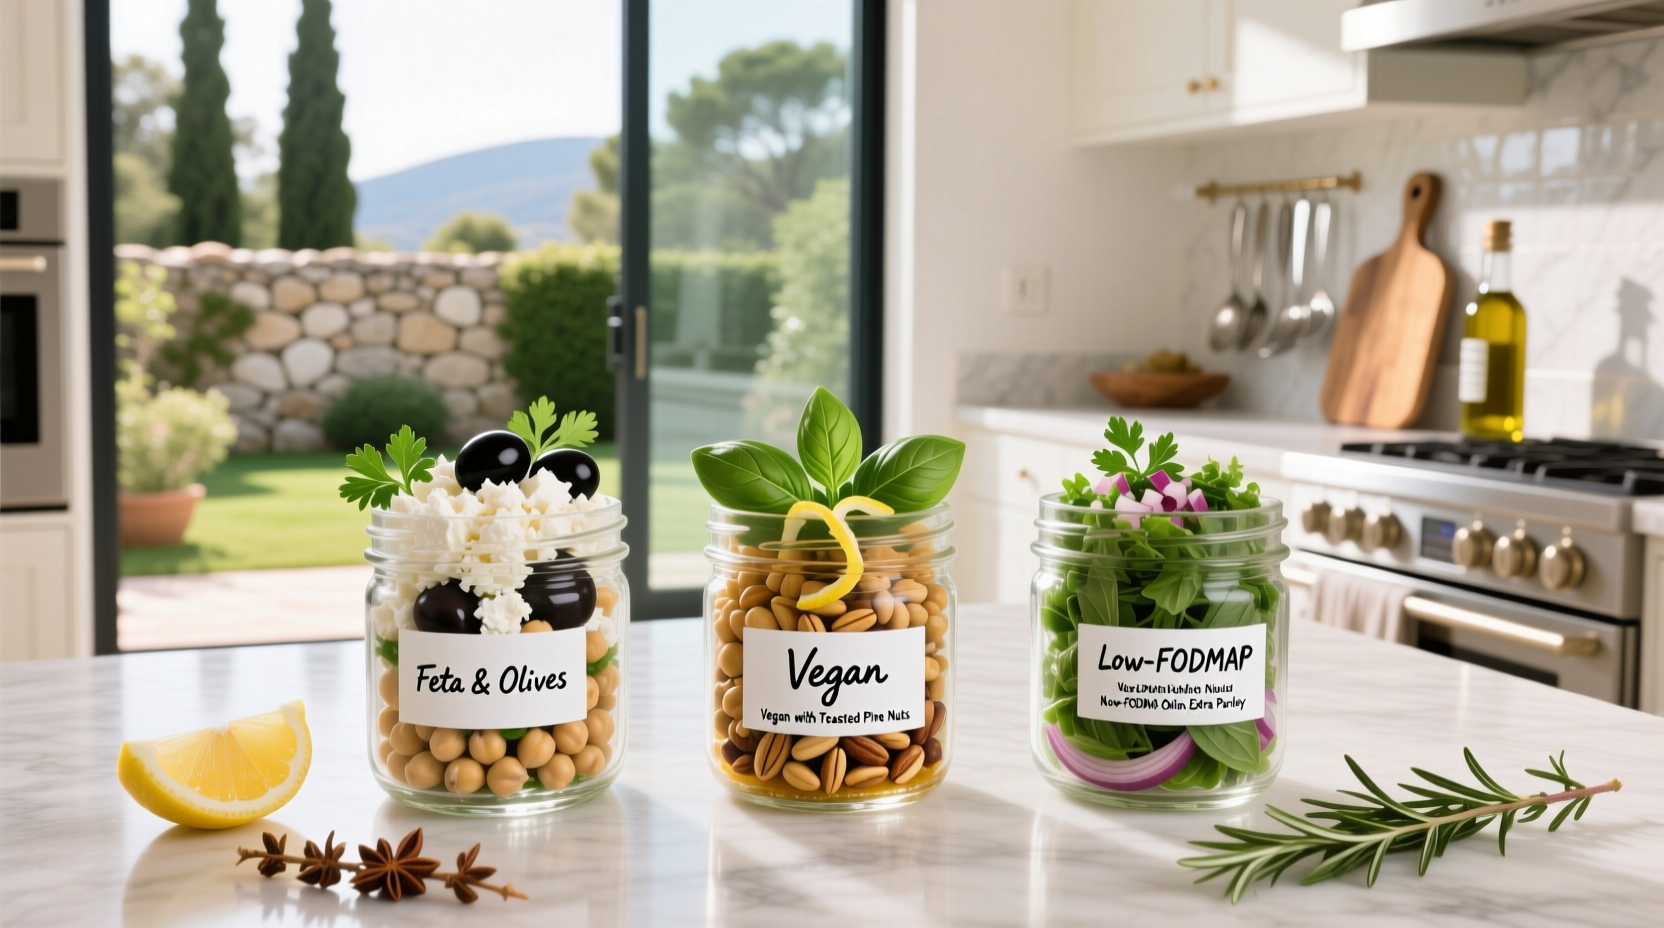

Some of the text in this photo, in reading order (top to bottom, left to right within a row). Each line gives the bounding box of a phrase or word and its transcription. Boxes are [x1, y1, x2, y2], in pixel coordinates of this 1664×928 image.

[1098, 643, 1253, 673] Low-FODMAP
[416, 663, 567, 695] Feta & Olives
[787, 646, 889, 707] Vegan
[760, 707, 790, 726] Vegan
[794, 710, 816, 724] with
[888, 709, 910, 722] Nuts
